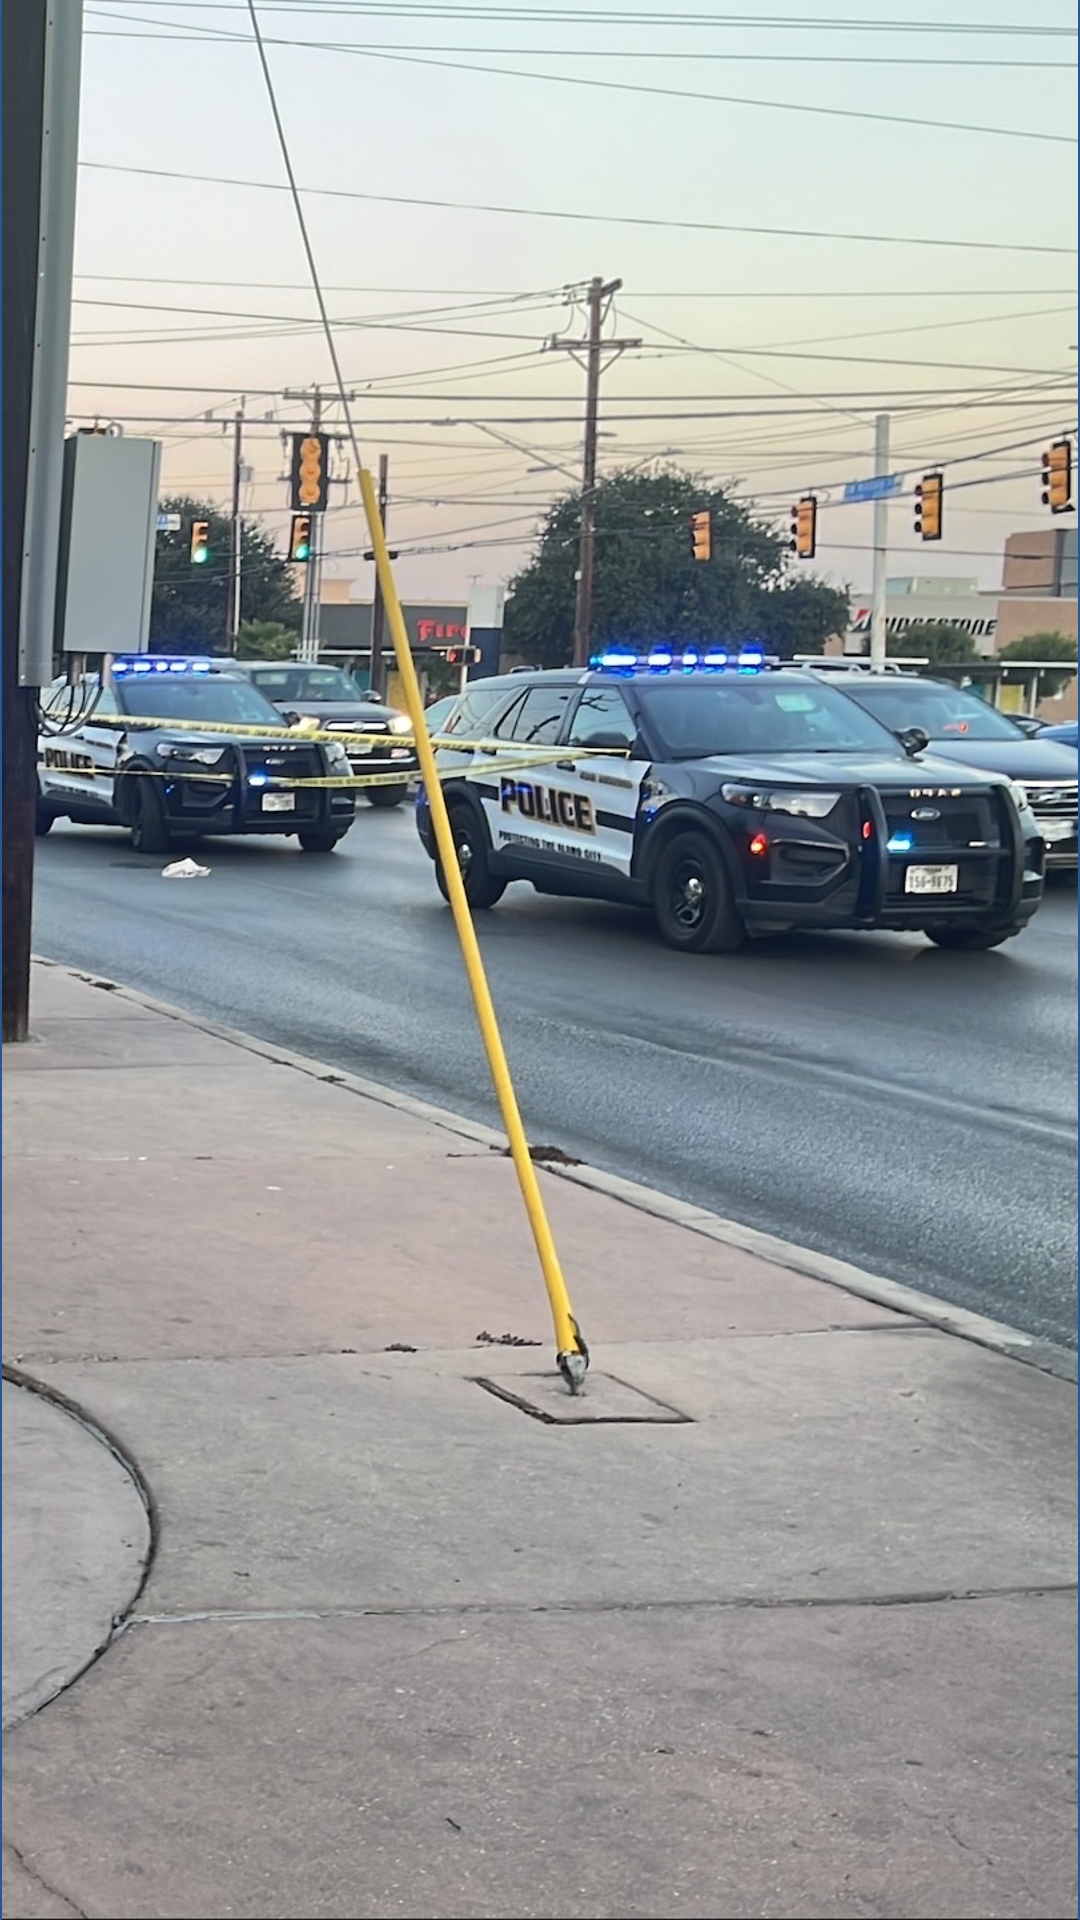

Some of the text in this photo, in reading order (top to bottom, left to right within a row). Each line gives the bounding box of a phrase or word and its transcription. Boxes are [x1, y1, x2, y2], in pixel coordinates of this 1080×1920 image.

[45, 747, 94, 780] POLICE
[500, 777, 597, 836] POLICE
[498, 830, 601, 861] PROTECTING THE ALAMO CITY
